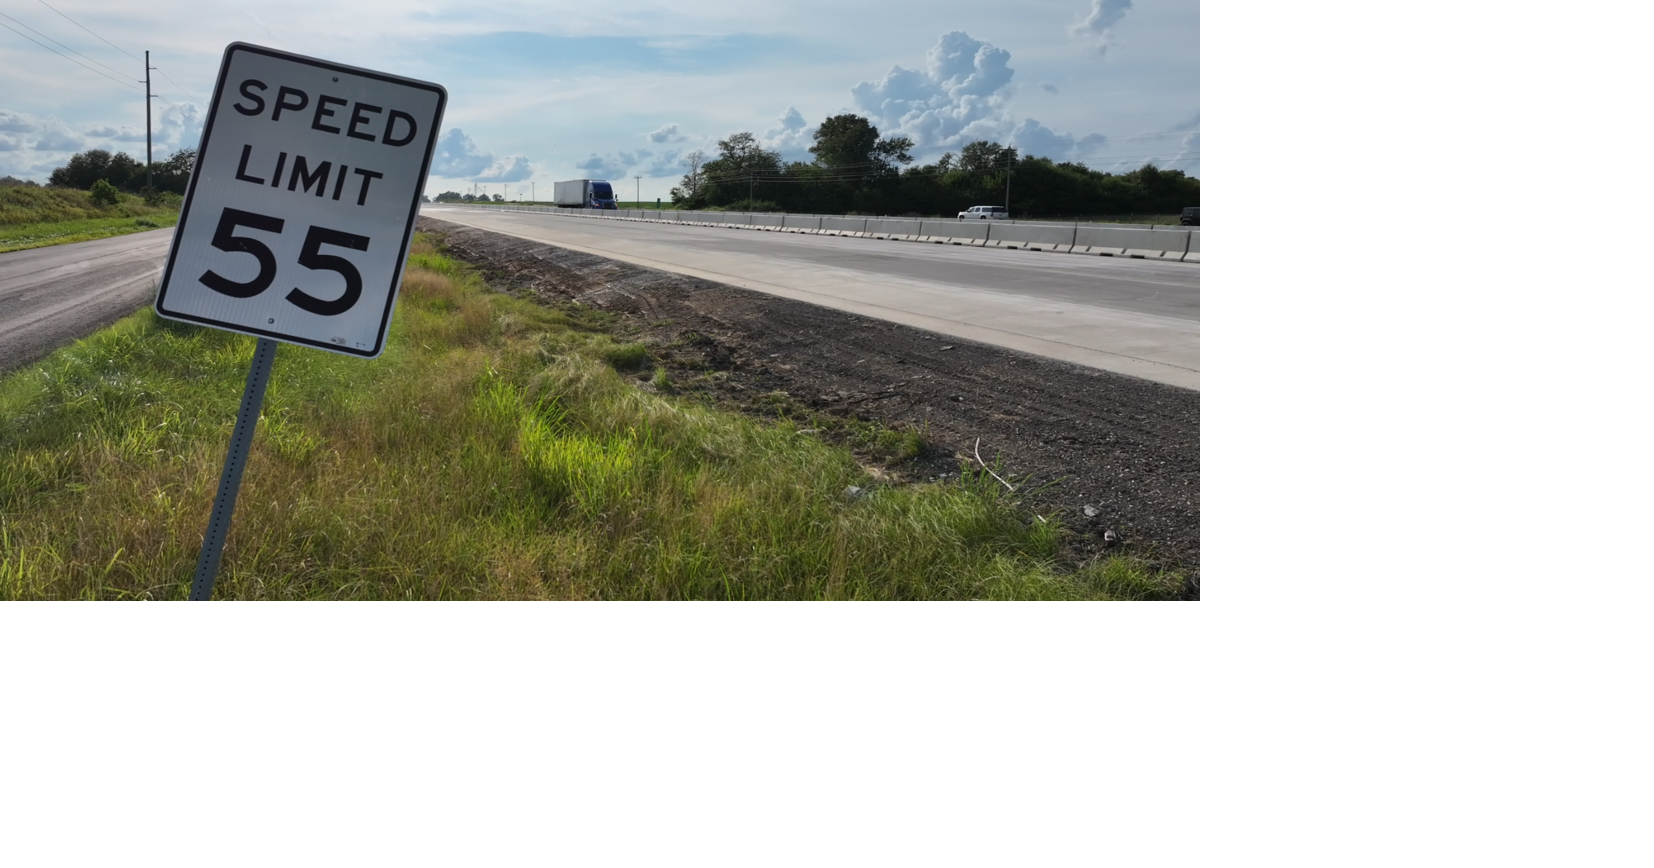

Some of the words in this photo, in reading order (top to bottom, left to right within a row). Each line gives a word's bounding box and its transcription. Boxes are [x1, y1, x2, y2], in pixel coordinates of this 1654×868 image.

[233, 79, 417, 147] SPEED
[235, 144, 383, 206] LIMIT
[198, 207, 370, 316] 55
